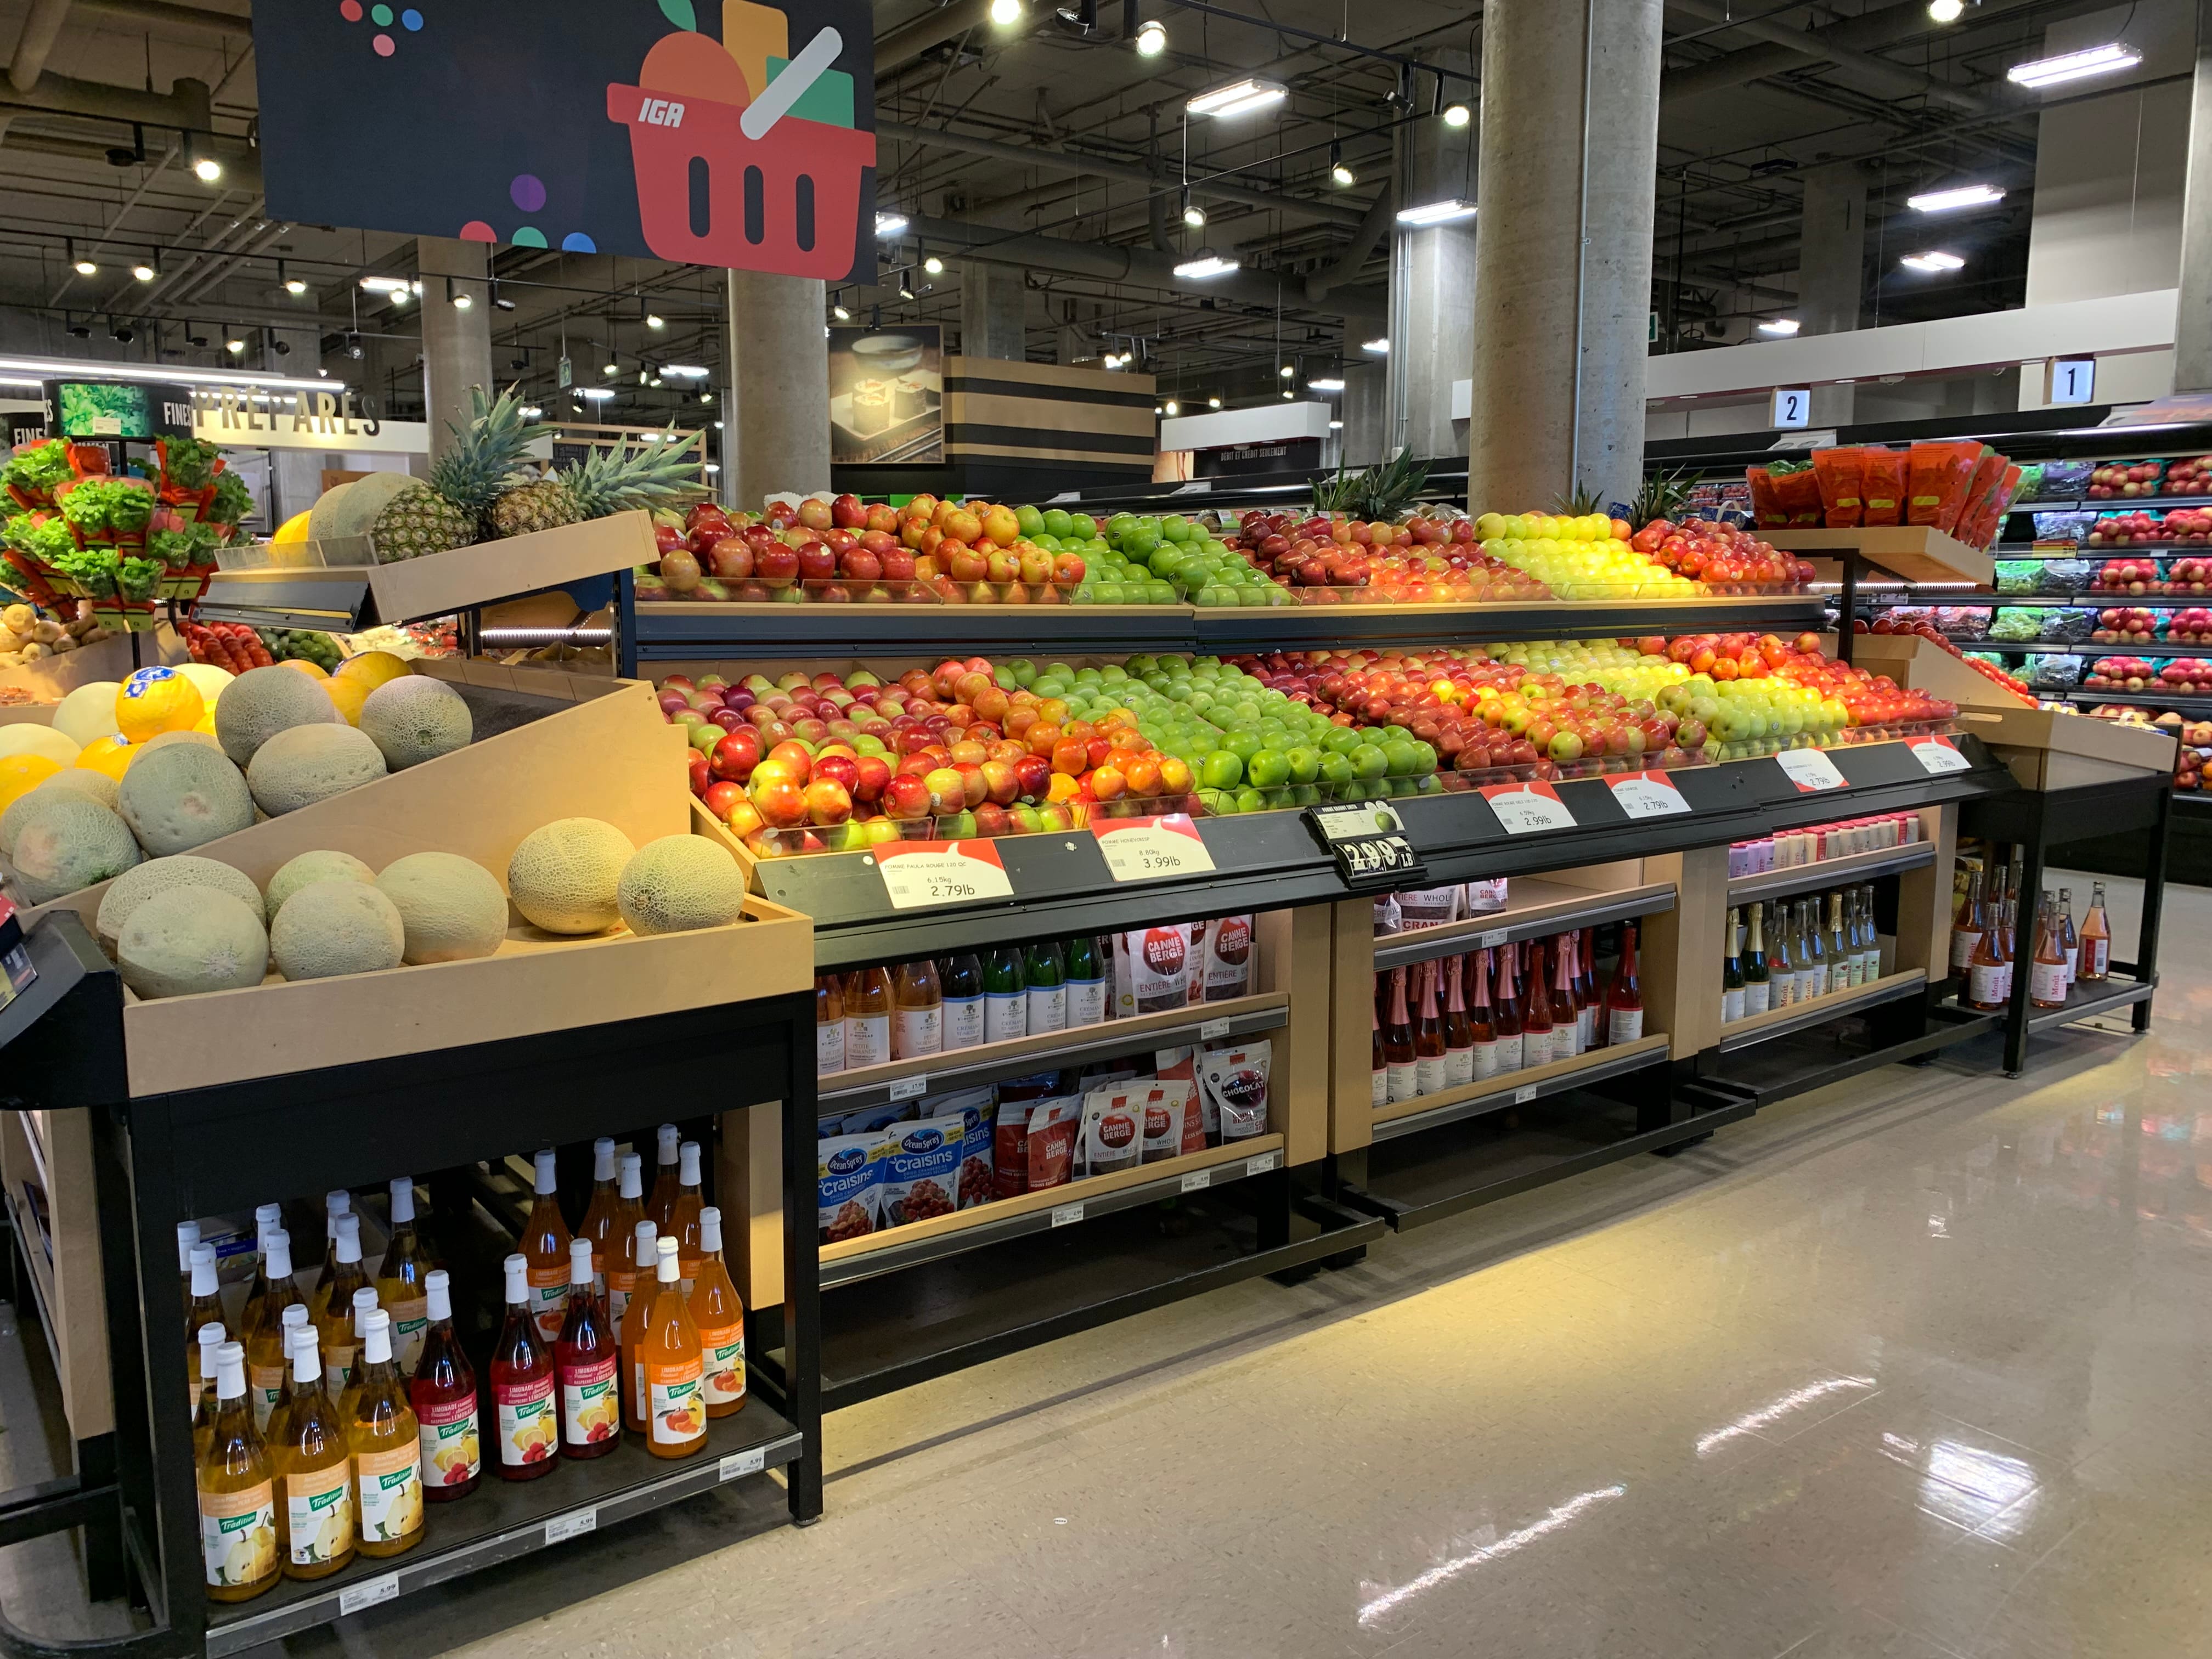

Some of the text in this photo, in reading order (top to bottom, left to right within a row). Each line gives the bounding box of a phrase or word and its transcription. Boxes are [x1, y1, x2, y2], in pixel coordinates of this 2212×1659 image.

[638, 98, 685, 128] IGA
[2067, 368, 2075, 396] 1
[163, 402, 191, 427] FINES
[1787, 396, 1797, 421] 2
[1643, 801, 1668, 810] 2.79lb
[1524, 815, 1552, 826] 2.99lb
[1143, 856, 1181, 868] 3.99lb
[1401, 853, 1414, 867] LB
[930, 884, 975, 896] 2.79lb
[1221, 927, 1247, 943] CANNE
[1148, 936, 1181, 952] CANNE
[1220, 937, 1249, 953] BERGE
[1150, 946, 1183, 963] BERGE
[1209, 969, 1237, 980] ENTIÈRE
[1140, 979, 1171, 992] ENTIÈRE
[1222, 1080, 1265, 1097] CHOCOLAT
[1144, 1114, 1166, 1124] ANNE
[1144, 1120, 1166, 1129] ERGE
[1103, 1121, 1130, 1133] CANNE
[1103, 1128, 1131, 1141] BERGE
[904, 1139, 923, 1149] Ocean
[923, 1135, 940, 1149] Spray
[1046, 1138, 1066, 1152] CANNE
[1046, 1144, 1068, 1160] BERGE
[830, 1154, 863, 1170] Ocean Spray
[895, 1150, 953, 1173] Craisins
[822, 1169, 873, 1197] Craisins
[716, 1344, 740, 1358] Tradition
[575, 1365, 599, 1374] LIMONADE
[509, 1384, 534, 1393] LIMONADE
[583, 1383, 610, 1398] Tradition
[669, 1382, 695, 1397] Tradition
[432, 1402, 457, 1413] LIMONADE
[518, 1401, 545, 1417] Tradition
[439, 1421, 469, 1439] Tradition
[381, 1469, 412, 1487] Tradition
[312, 1490, 343, 1508] Tradition
[221, 1515, 257, 1531] Tradition
